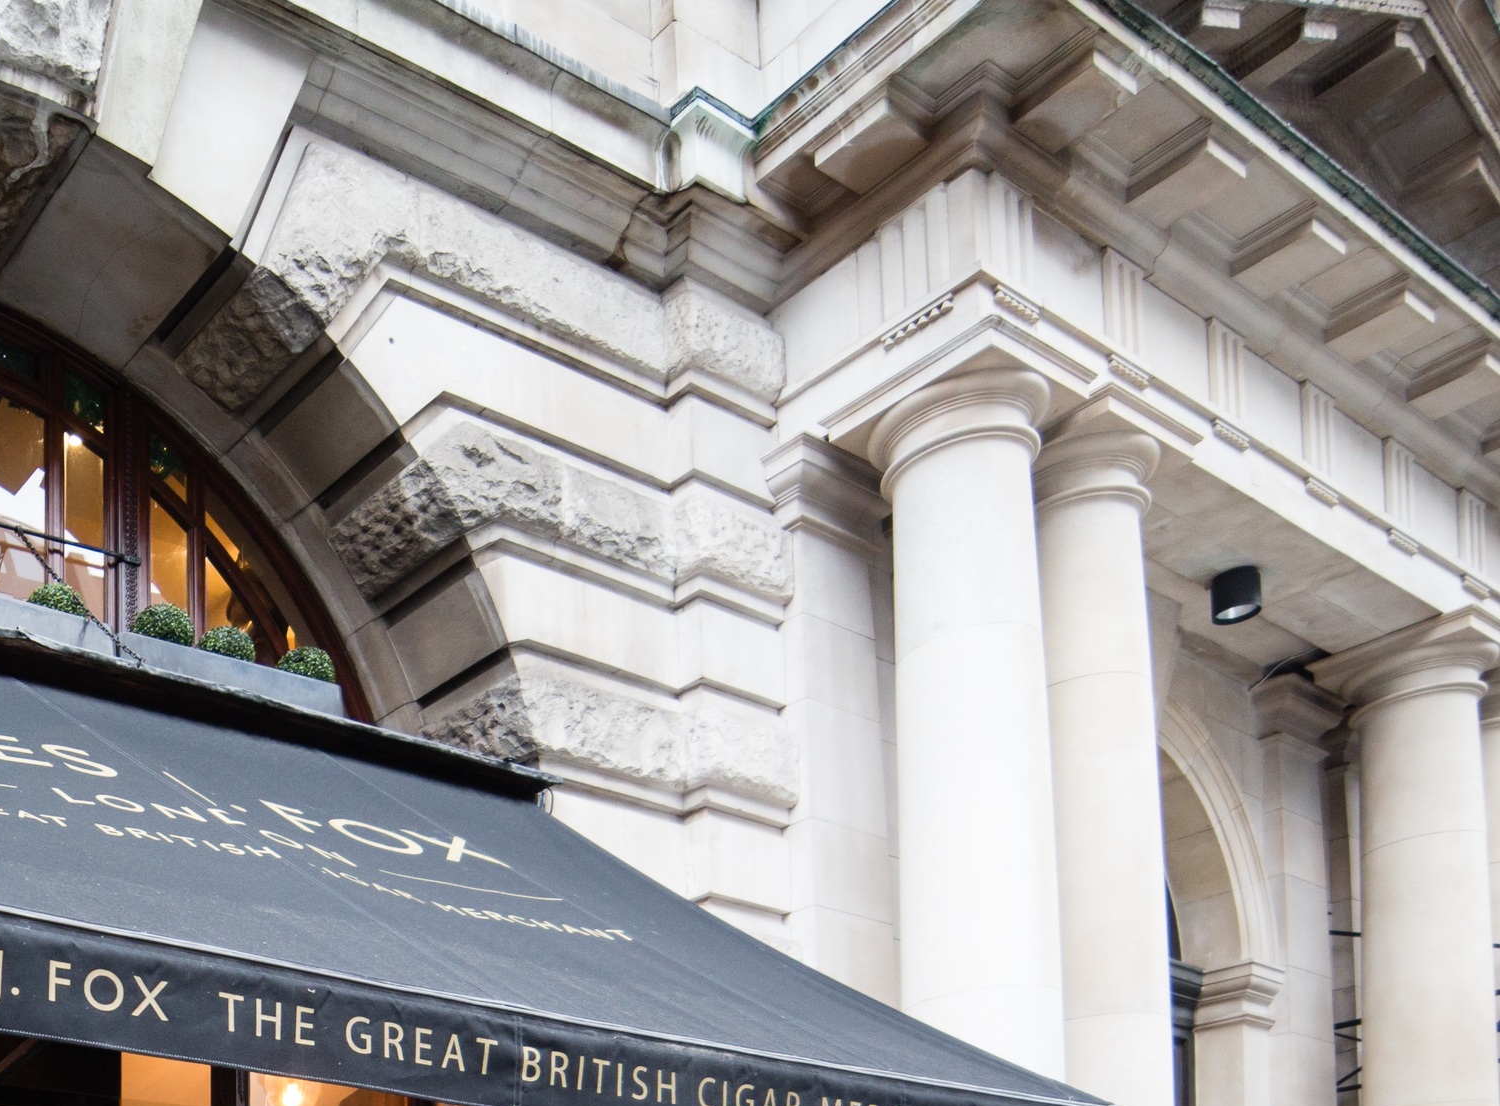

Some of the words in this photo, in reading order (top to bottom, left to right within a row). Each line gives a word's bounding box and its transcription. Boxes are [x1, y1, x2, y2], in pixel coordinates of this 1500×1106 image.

[94, 823, 281, 859] BRITISH
[431, 900, 633, 942] MERCHANT
[258, 799, 511, 869] FOX
[47, 959, 169, 1021] FOX
[218, 991, 316, 1047] THE
[345, 1016, 498, 1075] GREAT
[521, 1045, 677, 1105] BRITISH
